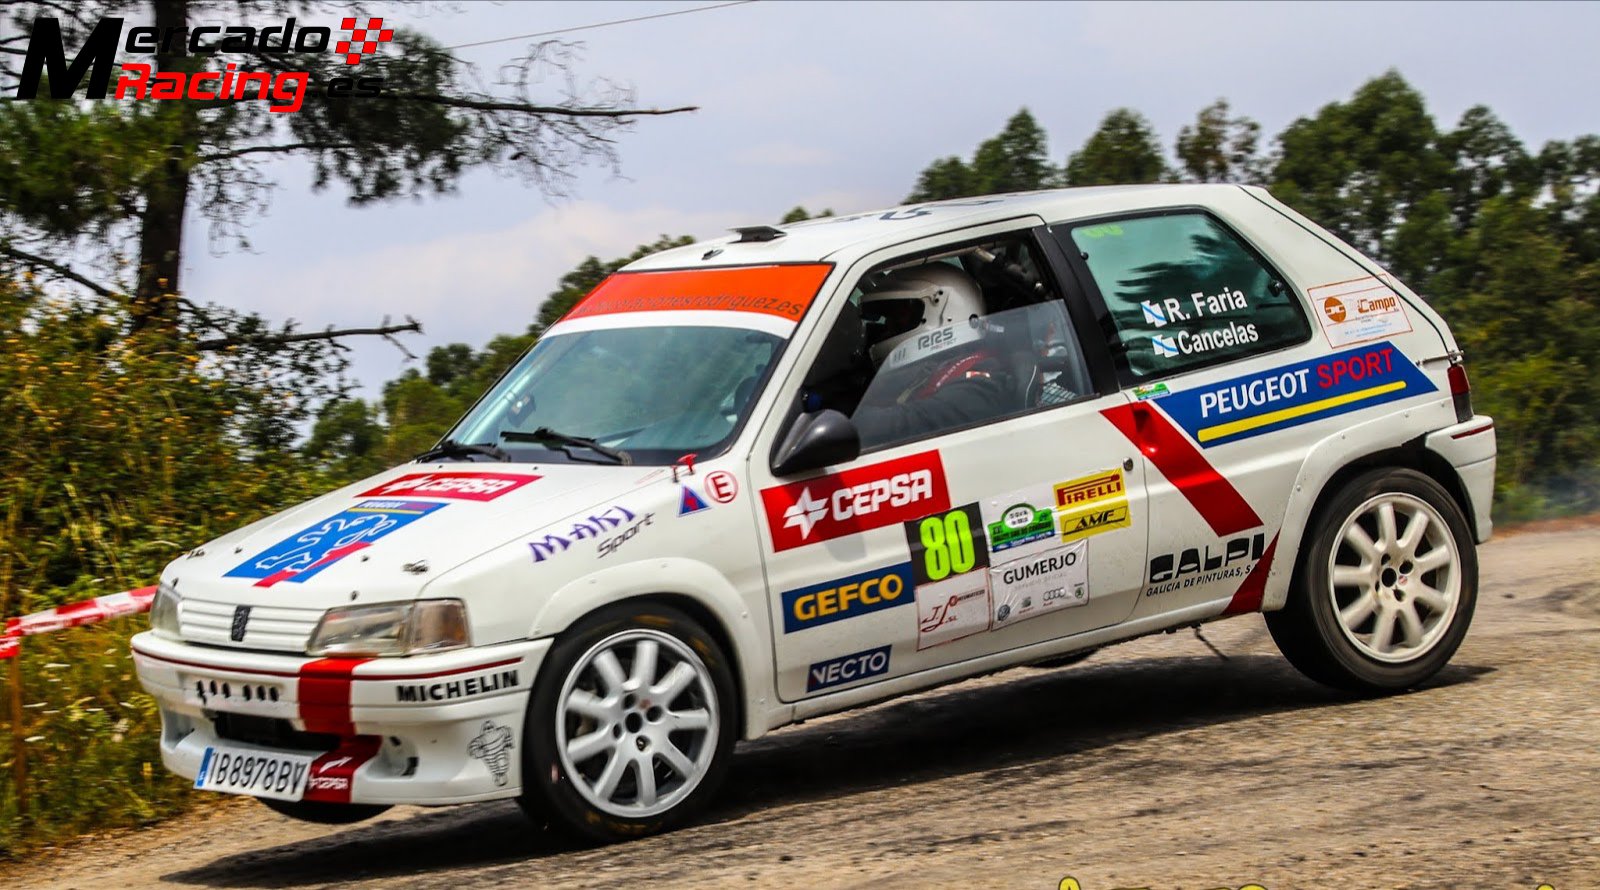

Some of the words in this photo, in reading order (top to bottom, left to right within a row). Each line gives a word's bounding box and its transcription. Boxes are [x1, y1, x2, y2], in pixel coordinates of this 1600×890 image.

[1165, 300, 1191, 324] R.
[1194, 286, 1248, 317] Faria
[918, 327, 953, 350] RRS
[1177, 321, 1259, 356] Cancelas
[1200, 369, 1310, 418] PEUGEOT
[1316, 348, 1394, 388] SPORT
[413, 478, 517, 494] CEPSA
[709, 474, 731, 499] E
[832, 468, 933, 522] CEPSA
[1057, 474, 1121, 506] PIRELLI
[529, 506, 636, 562] MAKI
[597, 512, 655, 559] Sport
[1074, 510, 1115, 529] AMF
[920, 509, 976, 581] 80
[1149, 532, 1264, 583] GALPI
[1003, 552, 1076, 584] GUMERJO
[1146, 582, 1181, 597] GALICIA
[1184, 577, 1195, 587] DE
[1196, 567, 1243, 584] PINTURAS,
[793, 574, 903, 621] GEFCO
[812, 653, 886, 684] VECTO
[396, 670, 519, 702] MICHELIN
